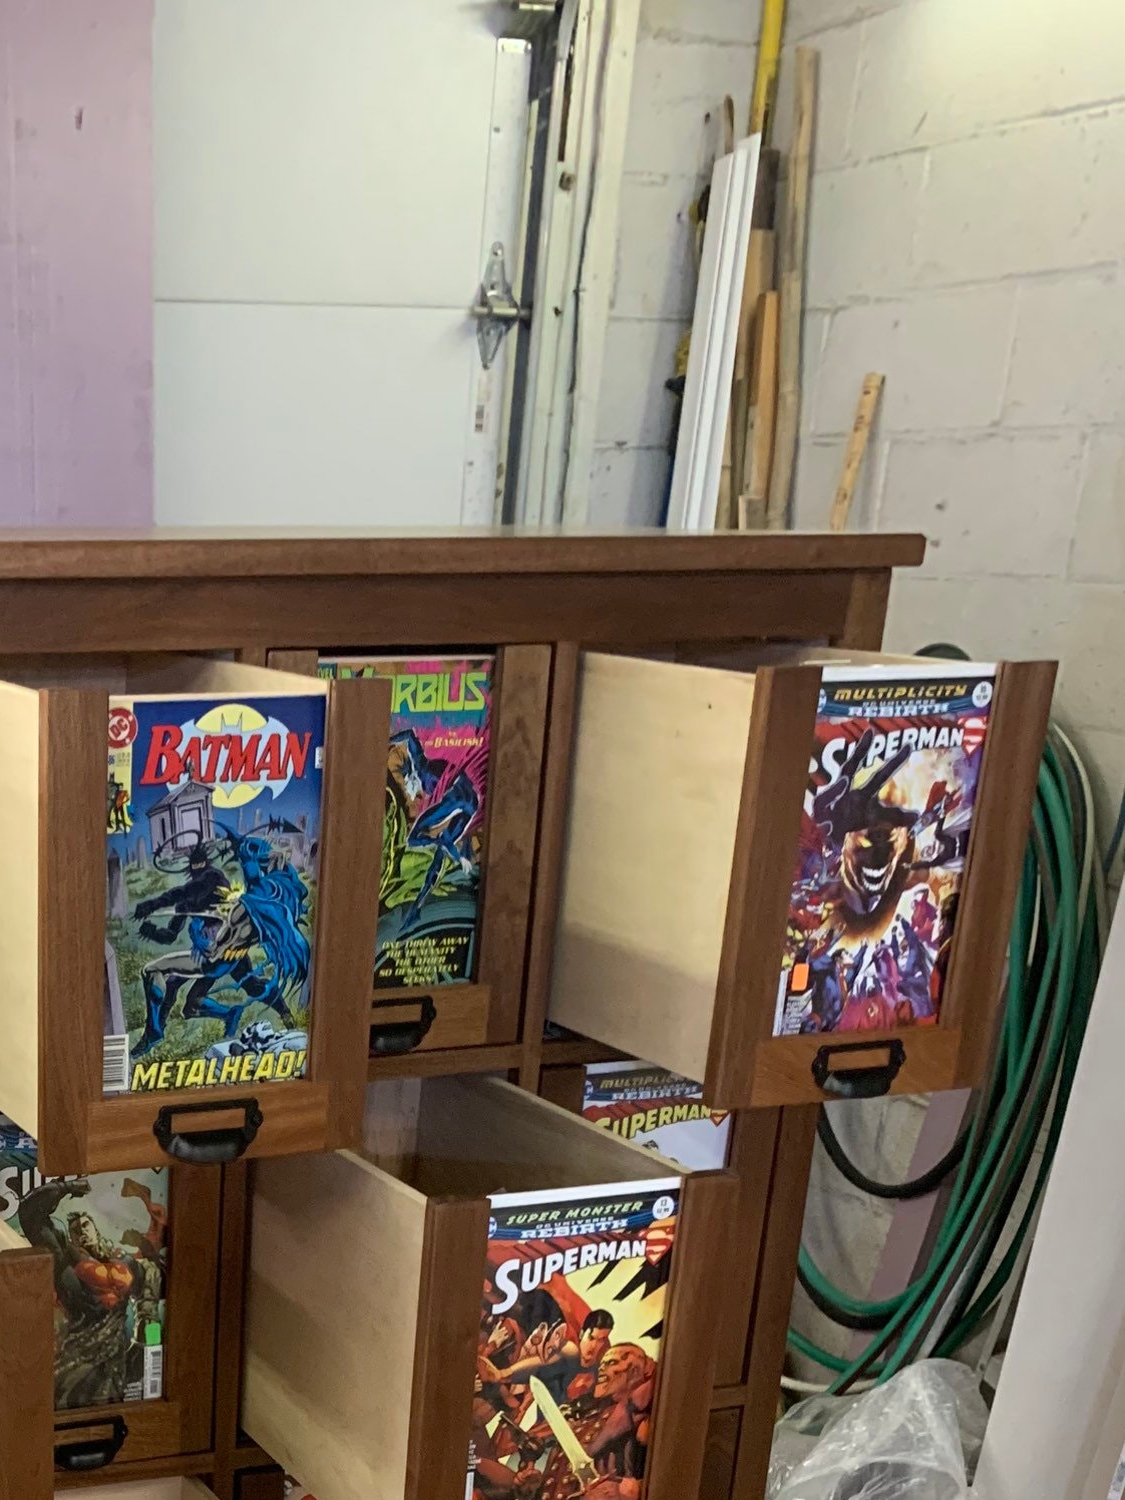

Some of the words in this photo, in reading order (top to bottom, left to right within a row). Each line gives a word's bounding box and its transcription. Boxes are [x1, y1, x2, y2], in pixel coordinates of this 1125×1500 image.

[340, 667, 487, 713] RBIUS
[848, 703, 949, 717] REBIRTH
[108, 718, 128, 737] DC
[140, 725, 313, 785] BATMAN
[131, 1050, 307, 1091] METALHEAD!
[507, 1210, 560, 1225] SUPER
[566, 1201, 644, 1218] MONSTER
[520, 1218, 628, 1239] REBIRTH
[491, 1240, 647, 1315] SUPERMAN
